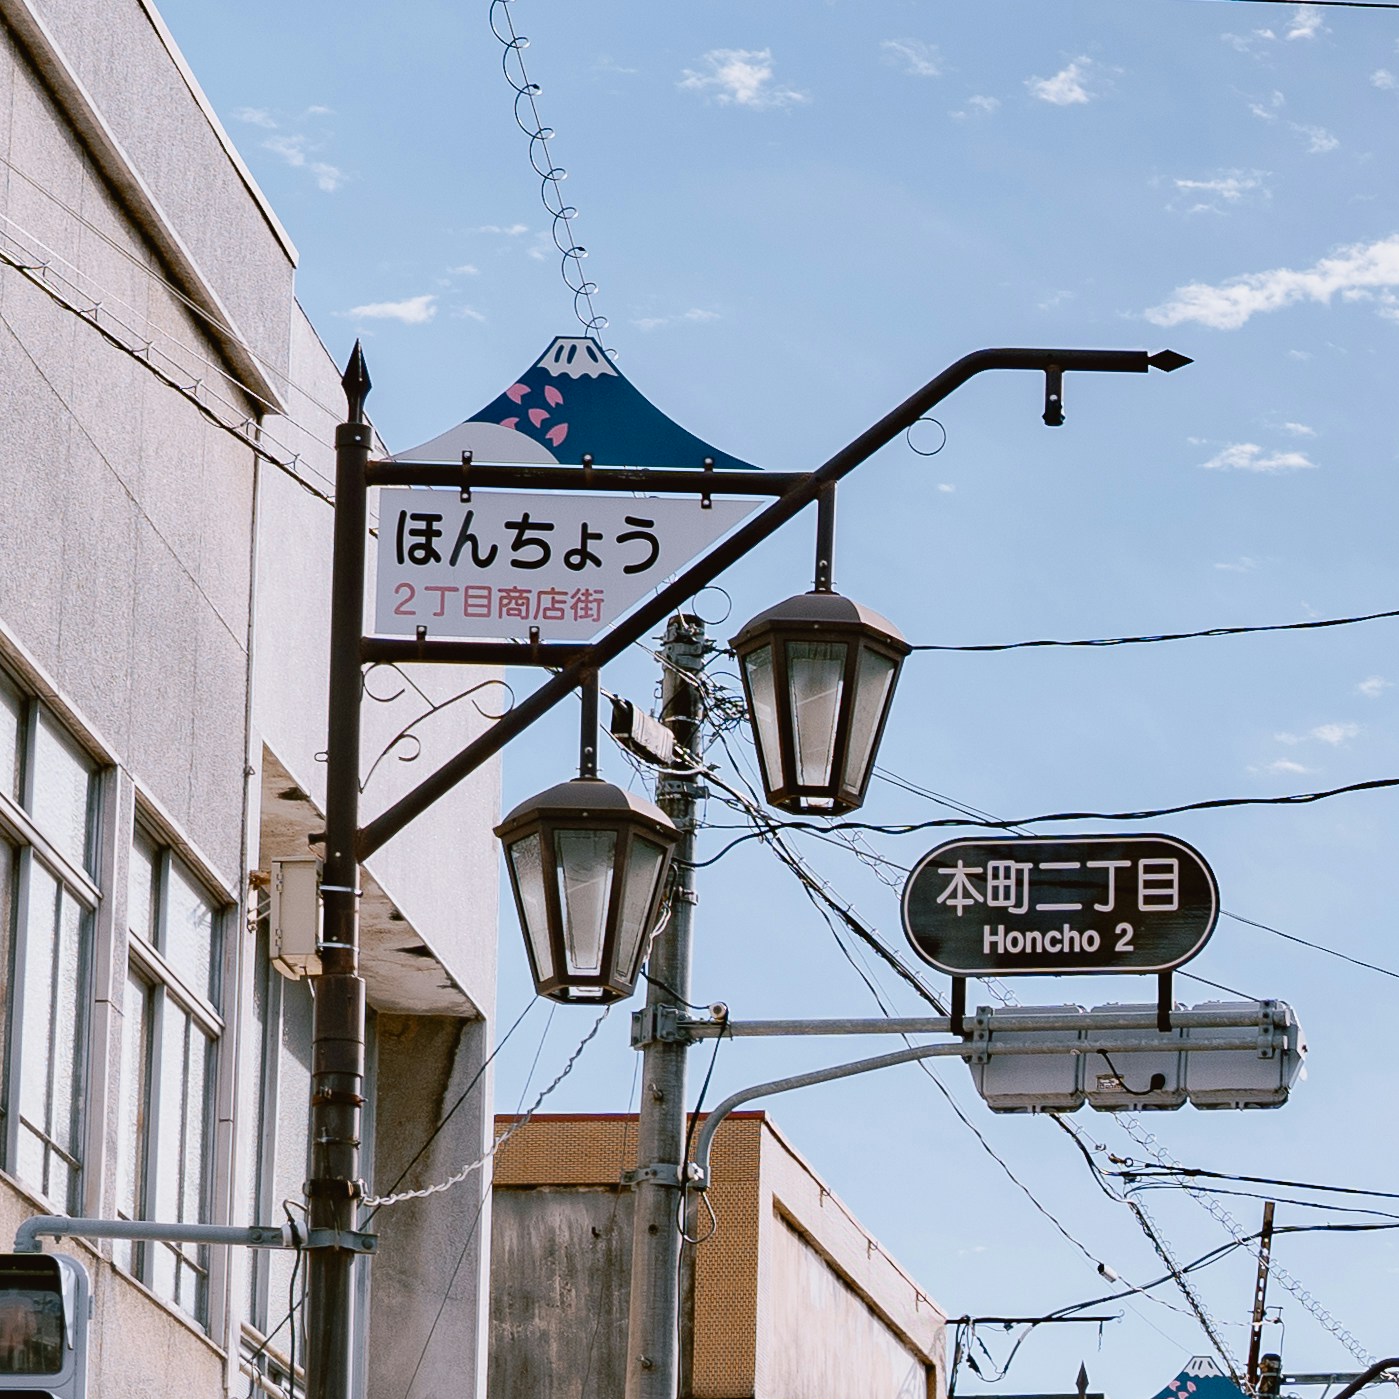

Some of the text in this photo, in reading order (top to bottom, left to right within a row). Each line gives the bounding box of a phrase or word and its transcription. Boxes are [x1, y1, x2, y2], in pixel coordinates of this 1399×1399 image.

[396, 509, 661, 575] ほんちょう
[393, 583, 604, 623] 2丁目商店街
[936, 857, 1181, 915] 本町二丁目
[982, 922, 1135, 956] Honcho 2
